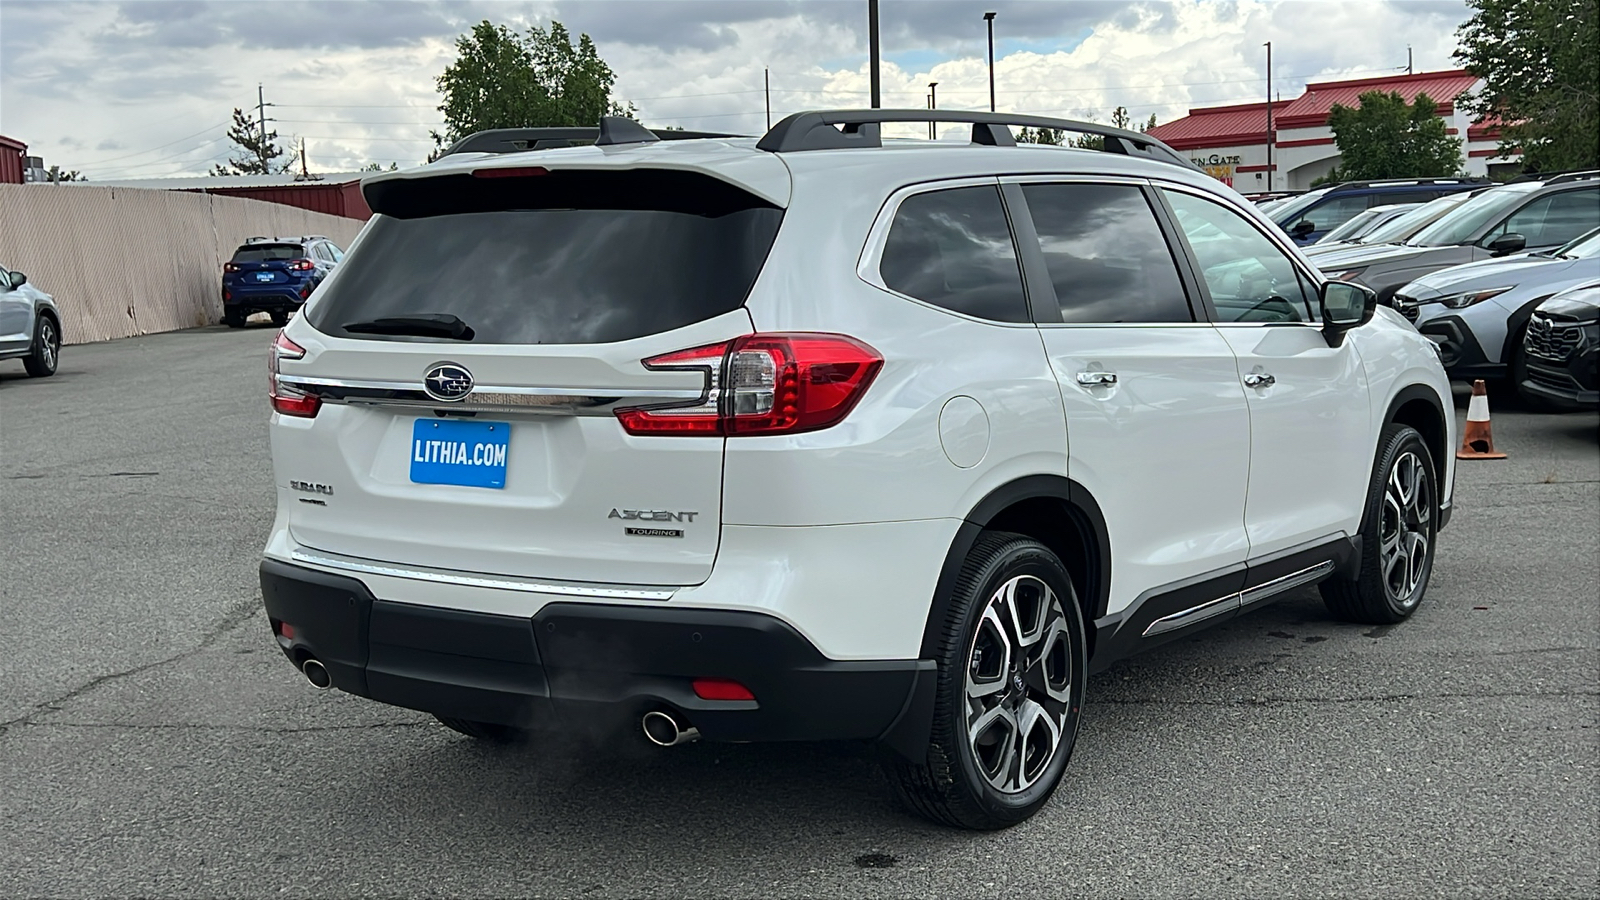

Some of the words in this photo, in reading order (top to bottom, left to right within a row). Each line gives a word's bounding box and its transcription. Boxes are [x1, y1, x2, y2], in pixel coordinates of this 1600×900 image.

[1209, 154, 1240, 165] GATE
[414, 439, 507, 467] LITHIA.COM
[607, 508, 699, 523] ASCENT
[630, 528, 677, 537] TOURING
